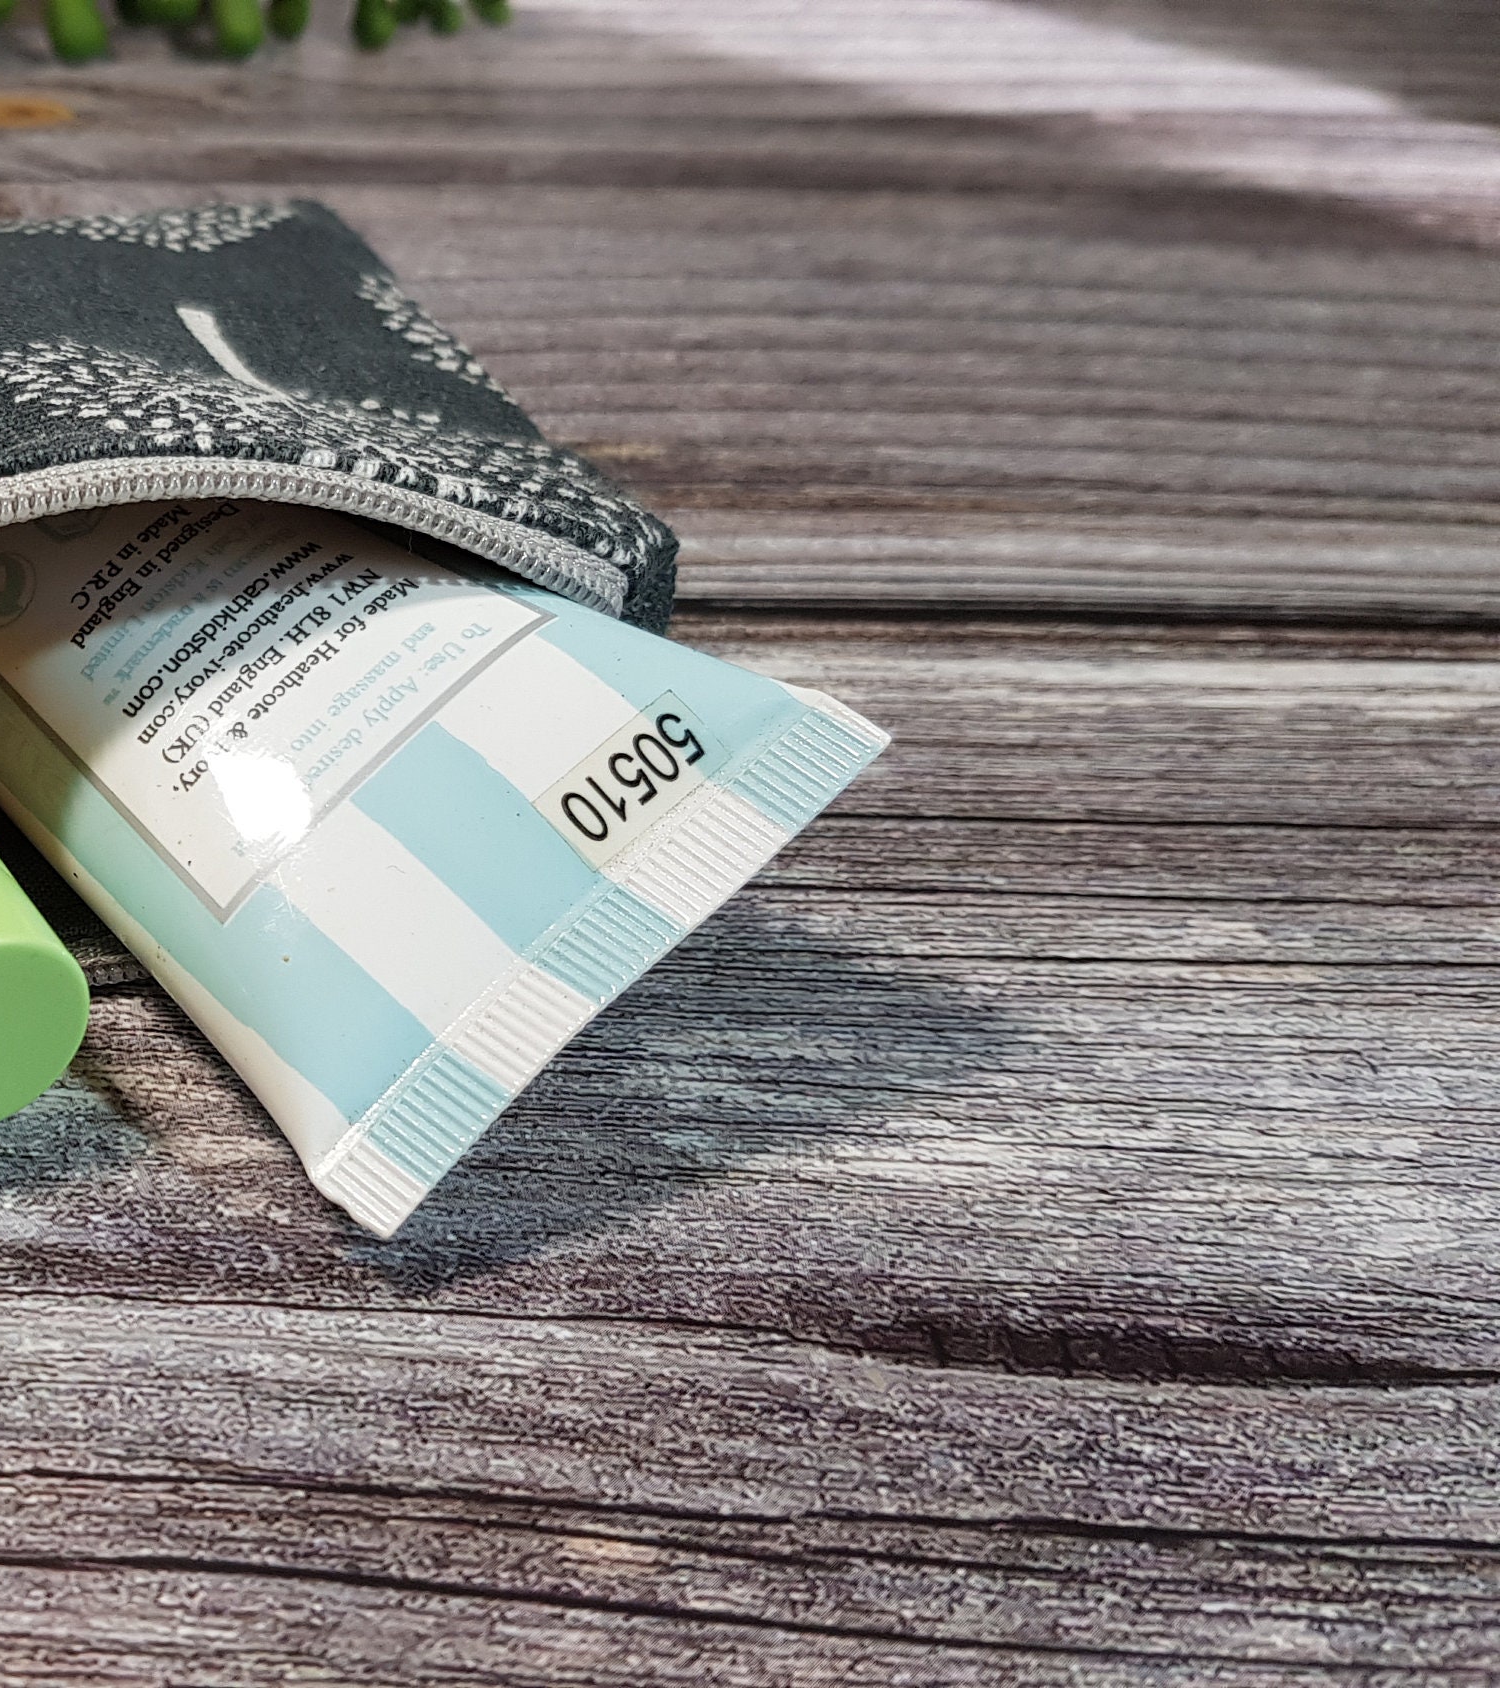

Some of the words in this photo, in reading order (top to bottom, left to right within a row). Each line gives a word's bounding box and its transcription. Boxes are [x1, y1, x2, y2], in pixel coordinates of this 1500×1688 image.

[136, 505, 192, 543] Made
[156, 503, 240, 564] Designed
[116, 540, 142, 560] in
[135, 559, 163, 578] in
[327, 568, 383, 606] NW1
[363, 577, 419, 615] Made
[70, 577, 143, 649] England
[122, 542, 323, 718] www.cathkidston.com
[279, 606, 331, 646] 8LH.
[334, 615, 366, 642] for
[461, 621, 492, 640] To
[112, 606, 195, 684] trademark
[137, 554, 354, 744] www.heathcote-ivory.com
[402, 623, 435, 652] and
[424, 642, 466, 676] Use:
[208, 645, 286, 717] England
[247, 640, 340, 719] Heathcote
[329, 652, 401, 716] massage
[363, 677, 418, 727] Apply
[162, 716, 209, 763] (UK)
[227, 722, 248, 740] &
[291, 719, 326, 751] into
[561, 713, 705, 841] 50510
